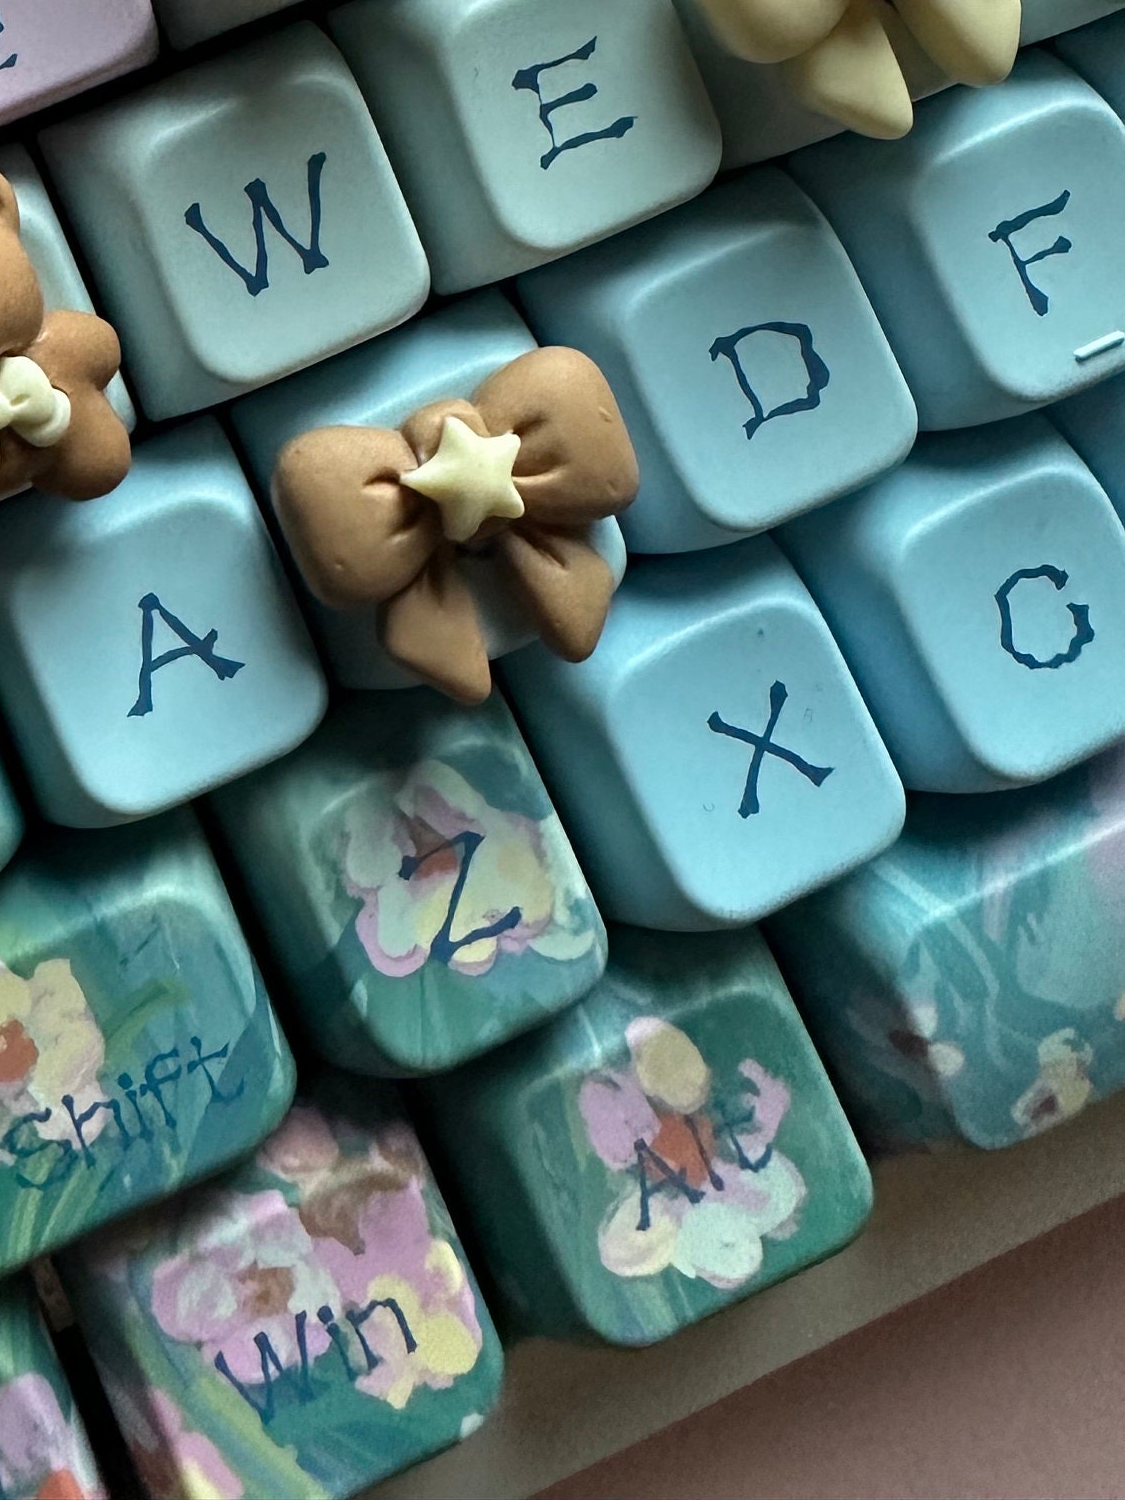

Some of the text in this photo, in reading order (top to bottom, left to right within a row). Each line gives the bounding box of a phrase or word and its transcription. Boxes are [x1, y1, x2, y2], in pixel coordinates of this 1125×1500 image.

[512, 36, 637, 169] E
[184, 152, 329, 296] W
[988, 190, 1071, 316] F
[709, 322, 829, 439] D
[127, 593, 246, 717] A
[994, 565, 1094, 669] C
[707, 681, 834, 818] X
[399, 832, 522, 962] Z
[214, 1298, 417, 1425] Win
